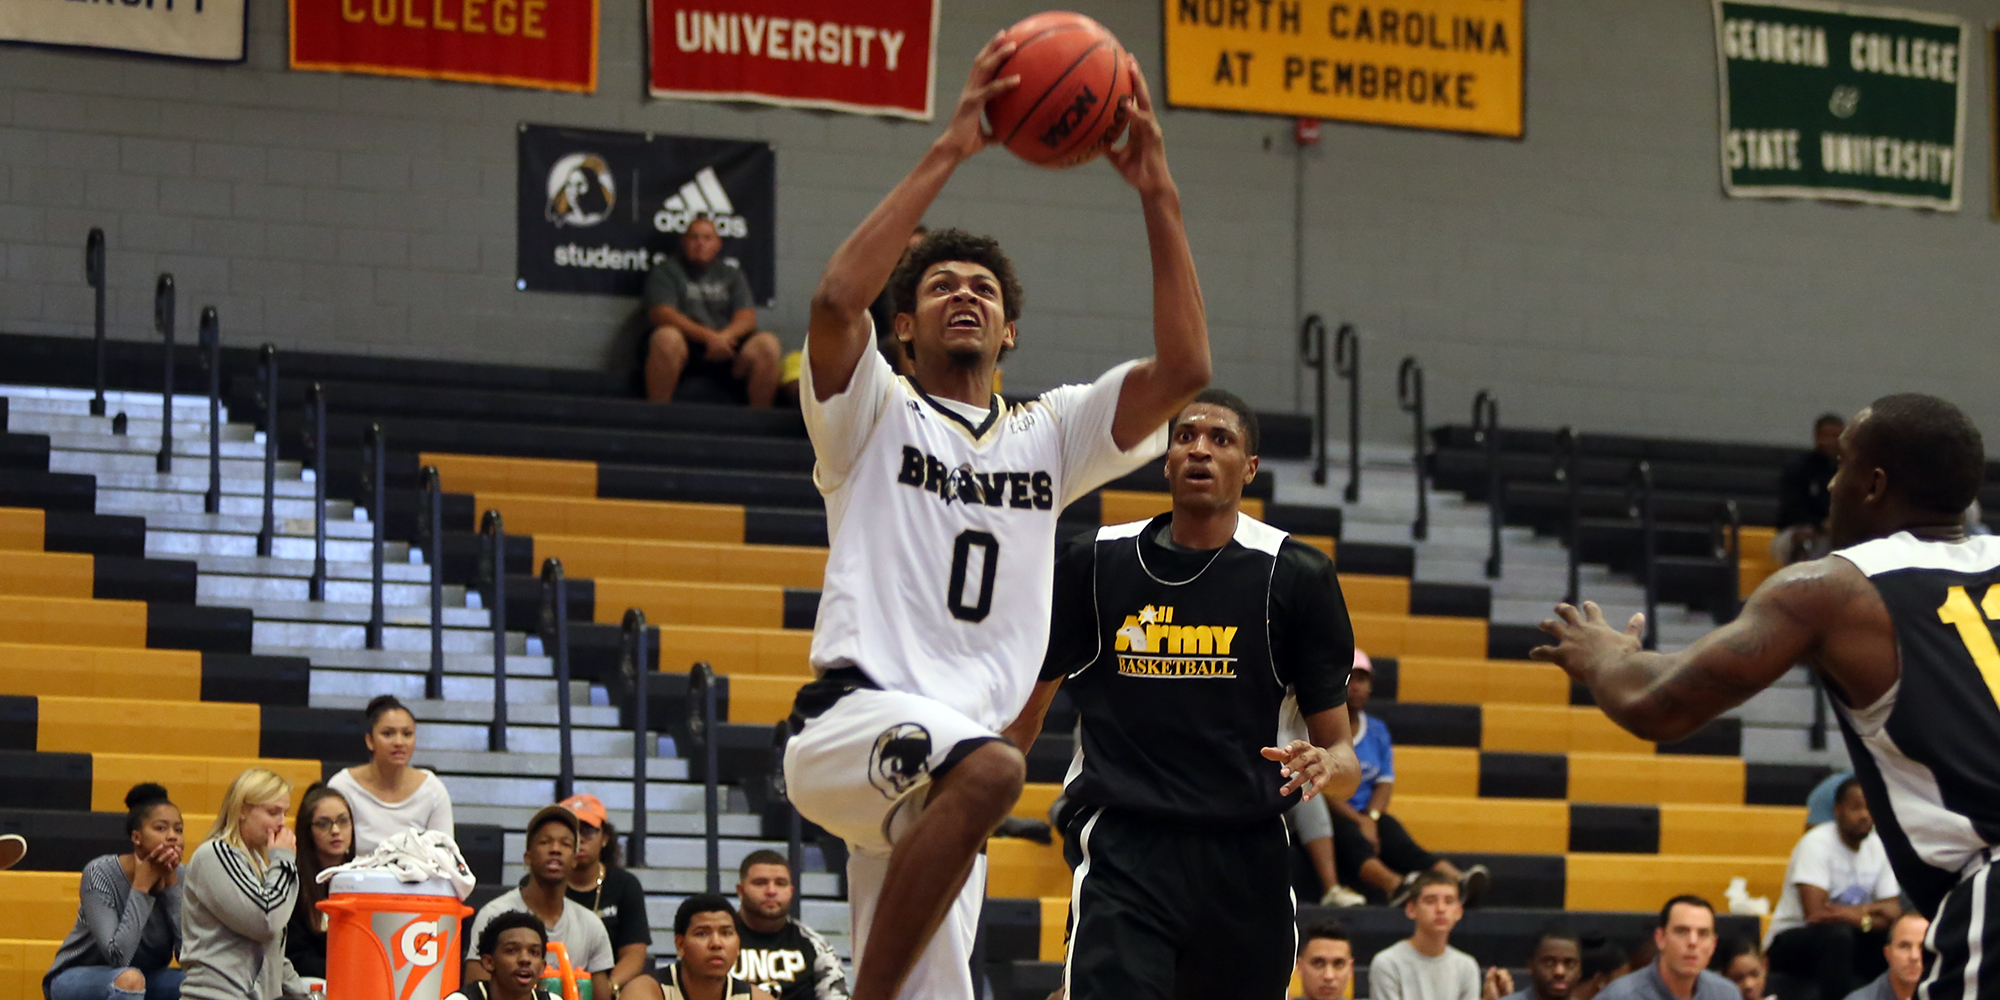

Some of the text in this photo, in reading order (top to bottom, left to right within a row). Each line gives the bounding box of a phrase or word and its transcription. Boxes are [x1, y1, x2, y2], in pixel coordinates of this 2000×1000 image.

[341, 0, 547, 39] COLLEGE
[675, 9, 905, 72] UNIVERSITY
[1177, 0, 1509, 56] NORTH CAROLINA
[1724, 18, 1957, 84] GEORGIA COLLEGE
[1214, 50, 1477, 110] AT PEMBROKE
[1726, 128, 1953, 186] STATE UNIVERSITY
[653, 209, 748, 239] adas
[553, 242, 649, 271] student
[947, 529, 999, 623] 0
[1118, 657, 1234, 676] BASKETBALL
[401, 921, 438, 967] G
[729, 948, 806, 982] UNCP
